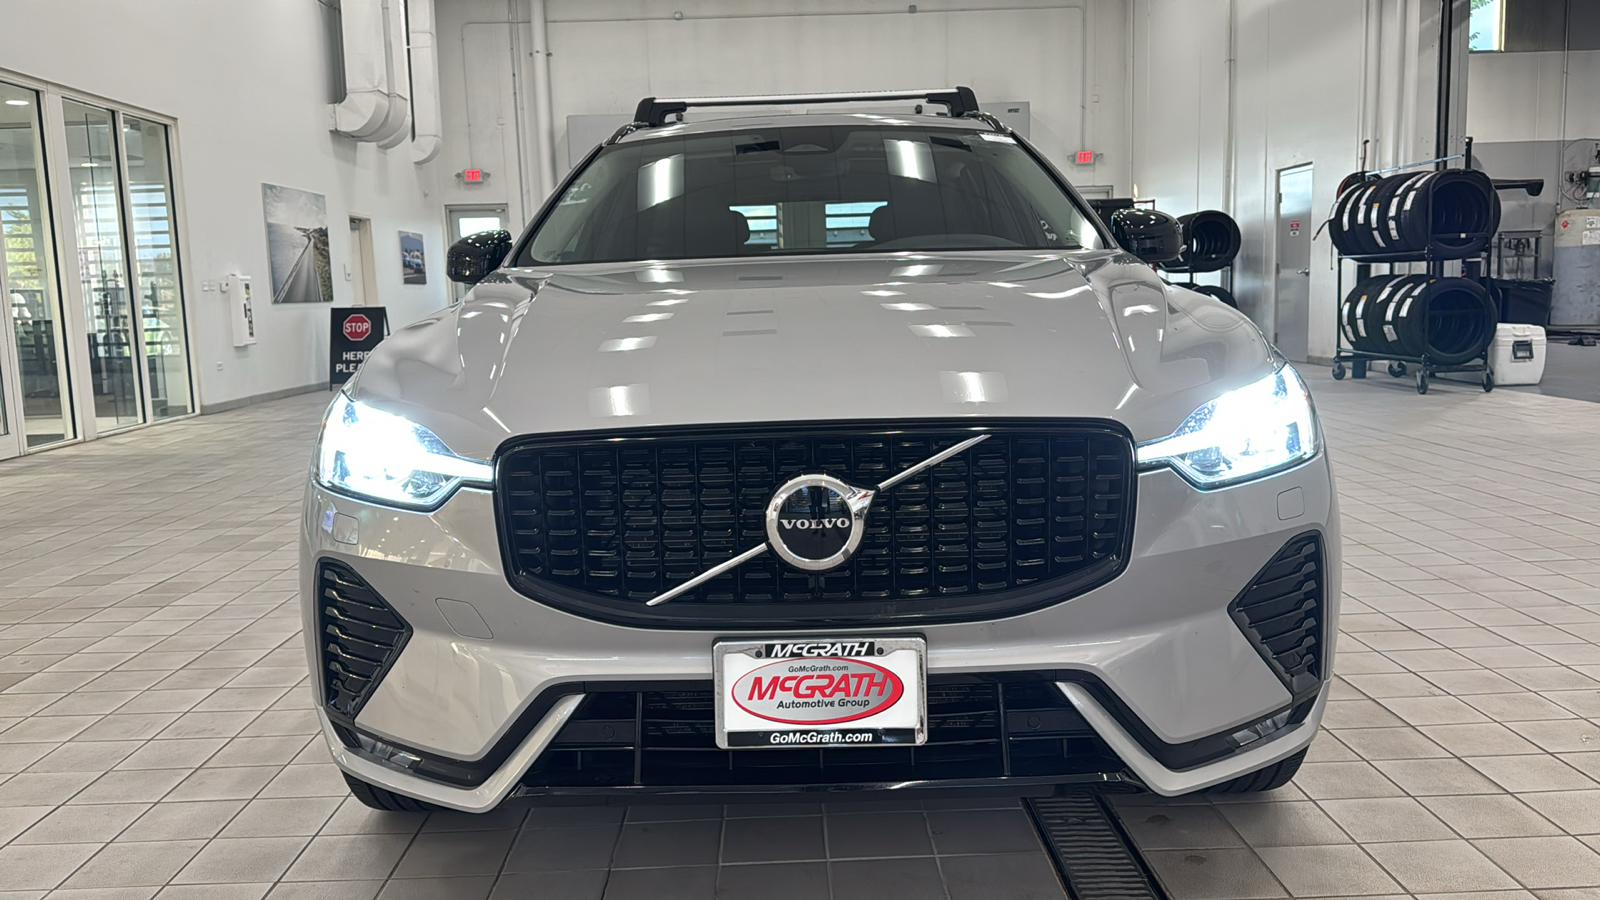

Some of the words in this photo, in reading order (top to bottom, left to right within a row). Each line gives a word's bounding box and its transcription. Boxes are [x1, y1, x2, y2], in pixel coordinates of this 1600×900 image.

[345, 322, 369, 333] STOP
[779, 518, 850, 529] VOLVO
[788, 665, 849, 673] GoMcGrath.com
[776, 700, 835, 709] Automotive
[837, 698, 870, 708] Group
[770, 731, 873, 744] GoMcGrath.com
